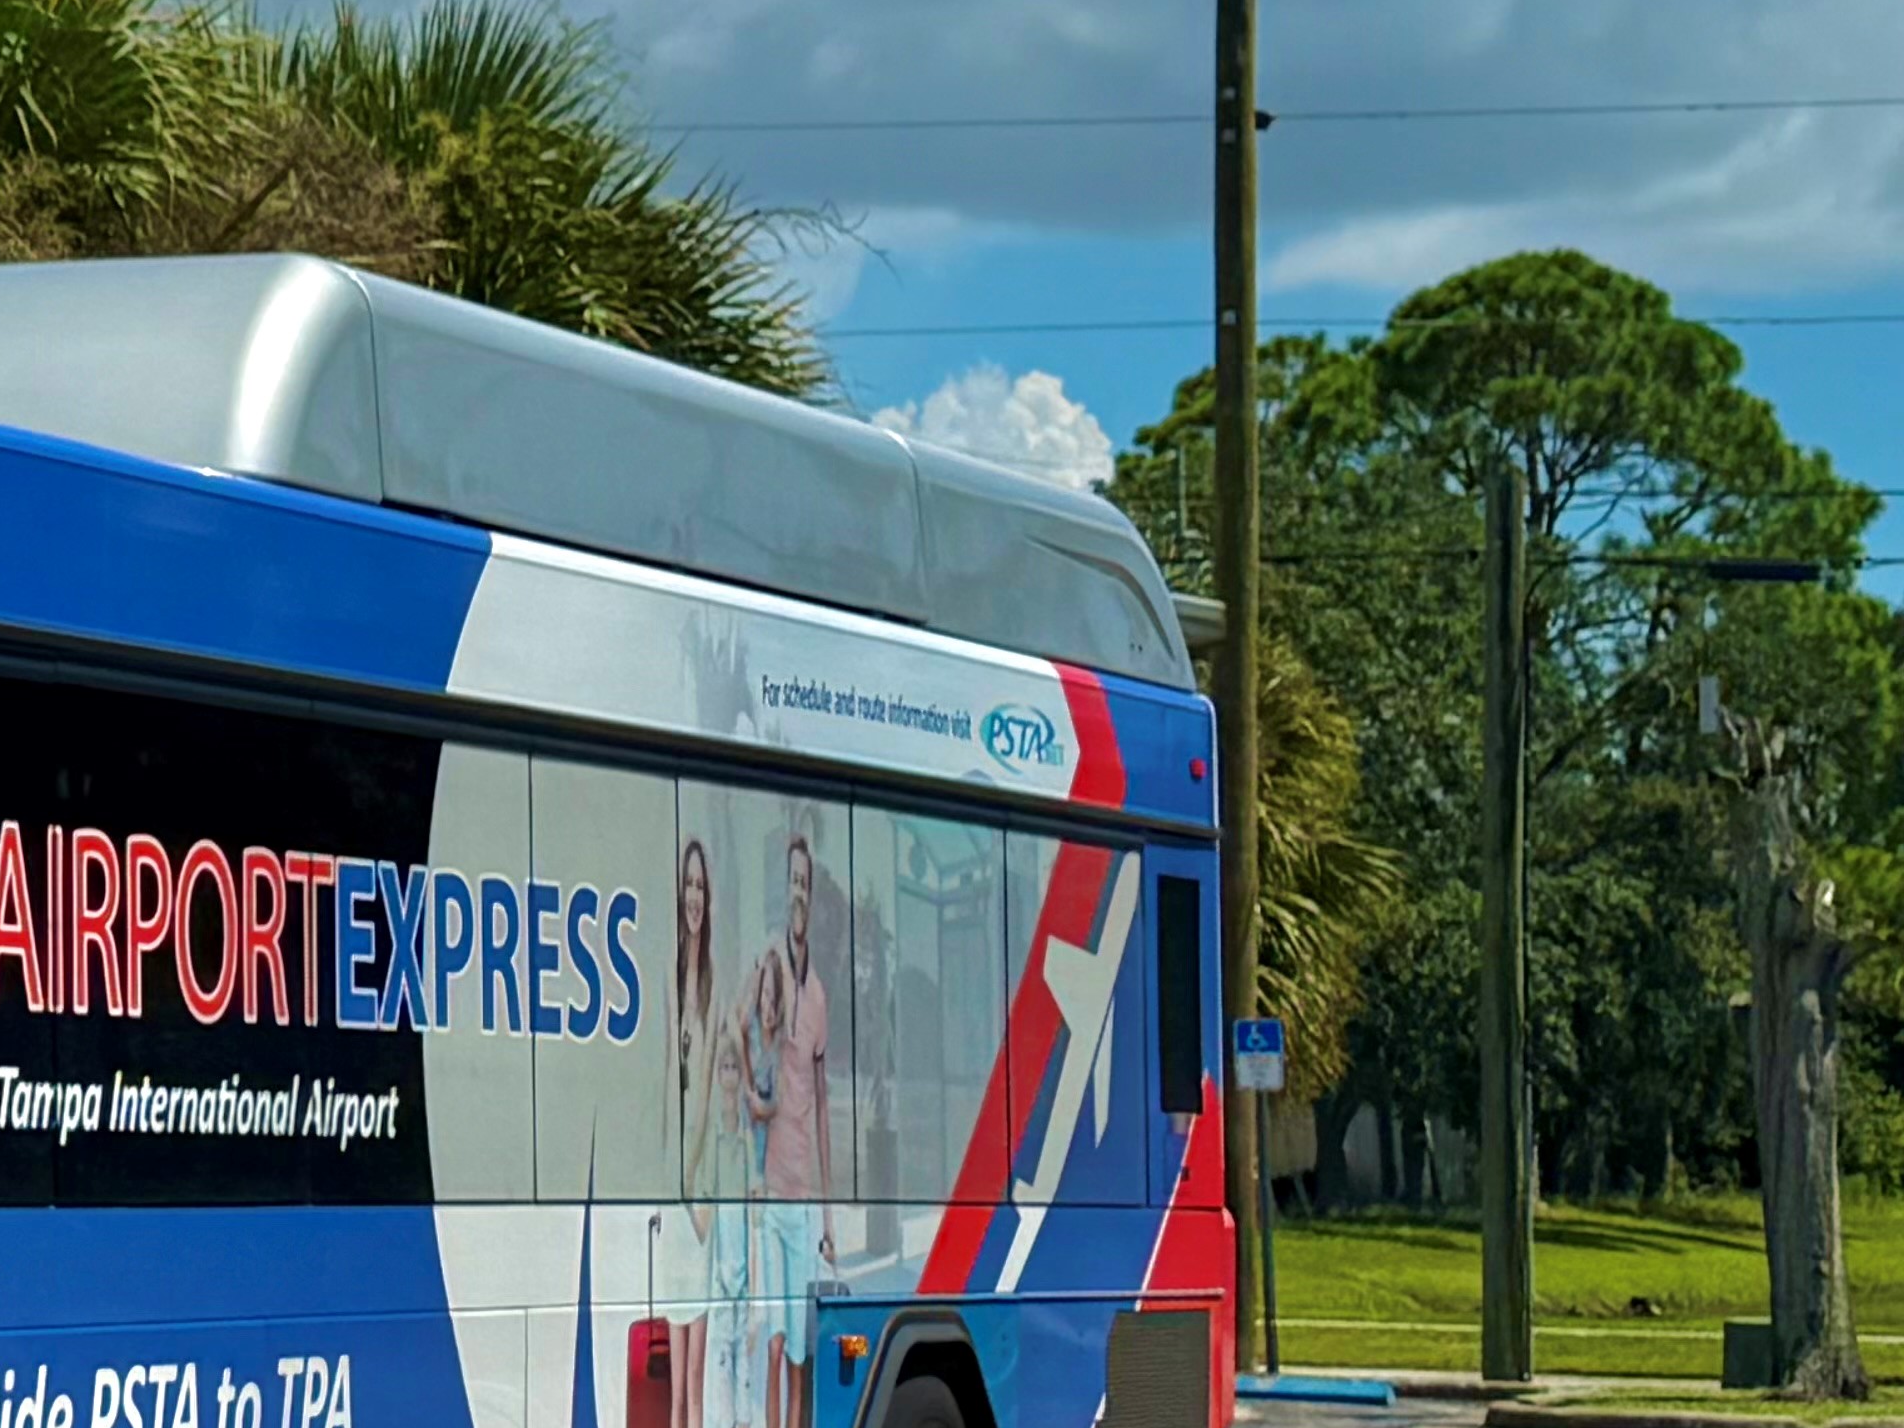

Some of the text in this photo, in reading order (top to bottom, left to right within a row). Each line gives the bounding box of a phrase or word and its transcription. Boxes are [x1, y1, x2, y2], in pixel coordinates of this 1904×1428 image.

[988, 711, 1043, 764] PSTA
[109, 1070, 300, 1136] International
[301, 1077, 399, 1152] Airport
